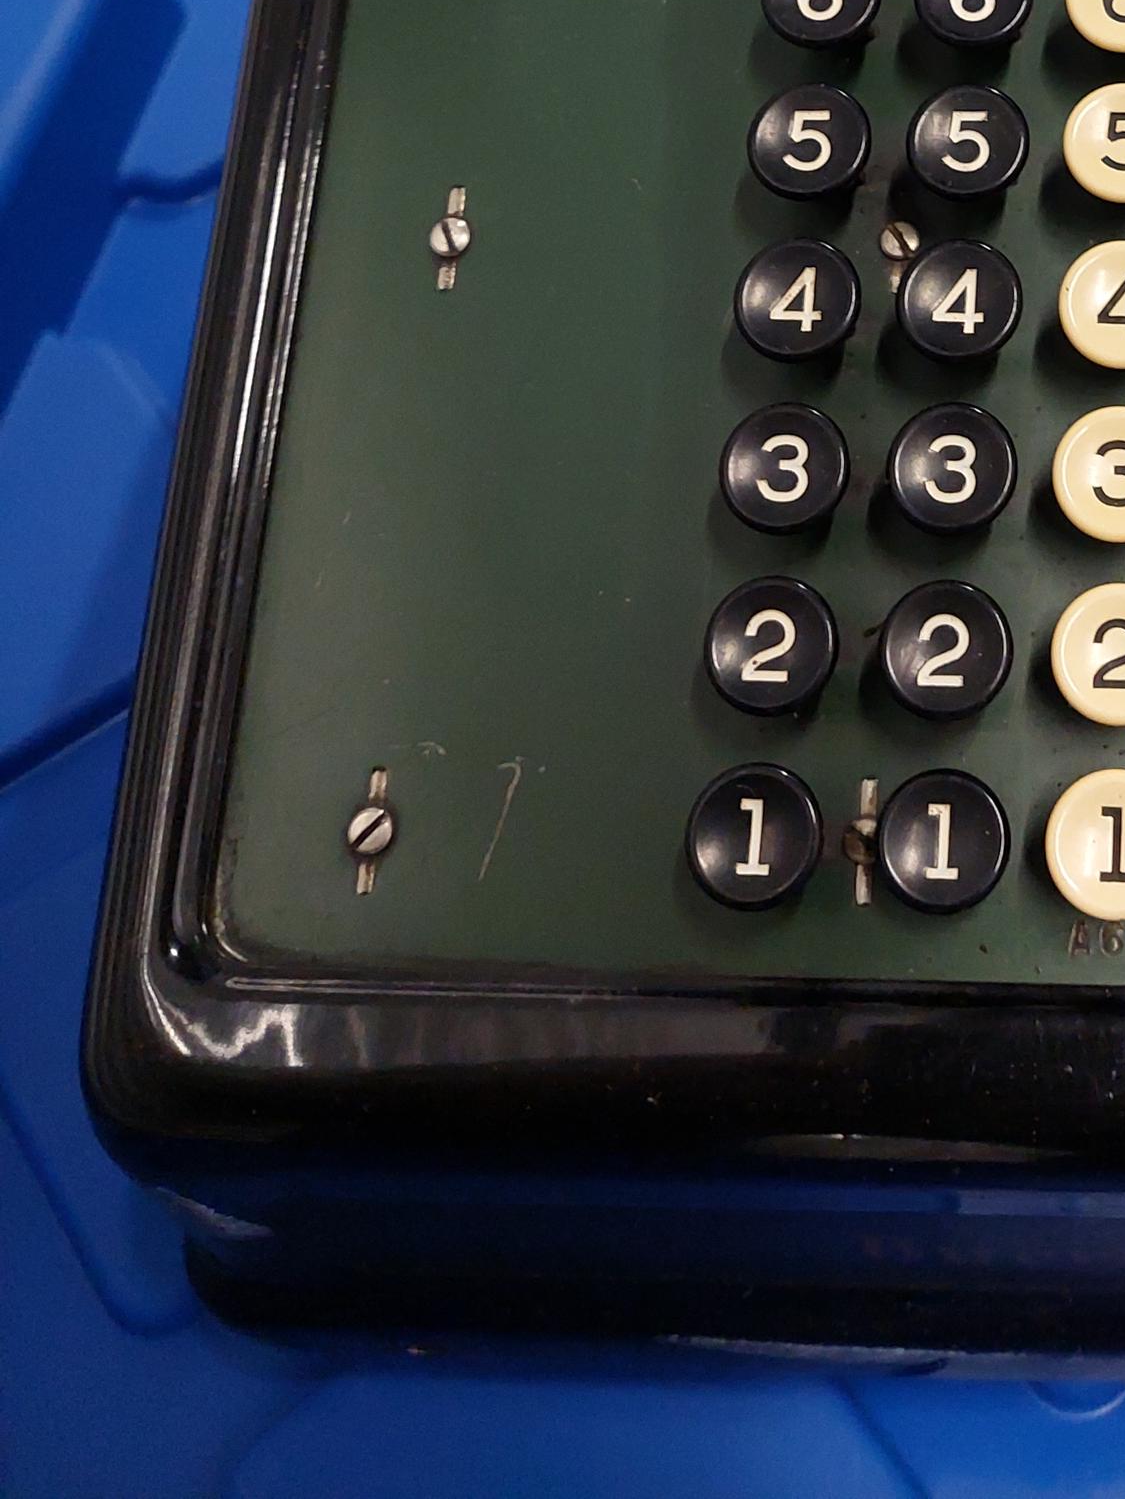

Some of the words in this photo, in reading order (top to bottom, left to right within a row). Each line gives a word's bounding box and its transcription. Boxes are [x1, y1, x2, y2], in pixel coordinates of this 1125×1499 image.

[782, 110, 832, 172] 5
[941, 111, 990, 173] 5
[769, 266, 822, 332] 4
[931, 268, 984, 334] 4
[756, 434, 809, 503] 3
[925, 434, 977, 504] 3
[741, 609, 796, 683] 2
[916, 613, 970, 688] 2
[735, 798, 770, 876] 1
[924, 803, 959, 880] 1
